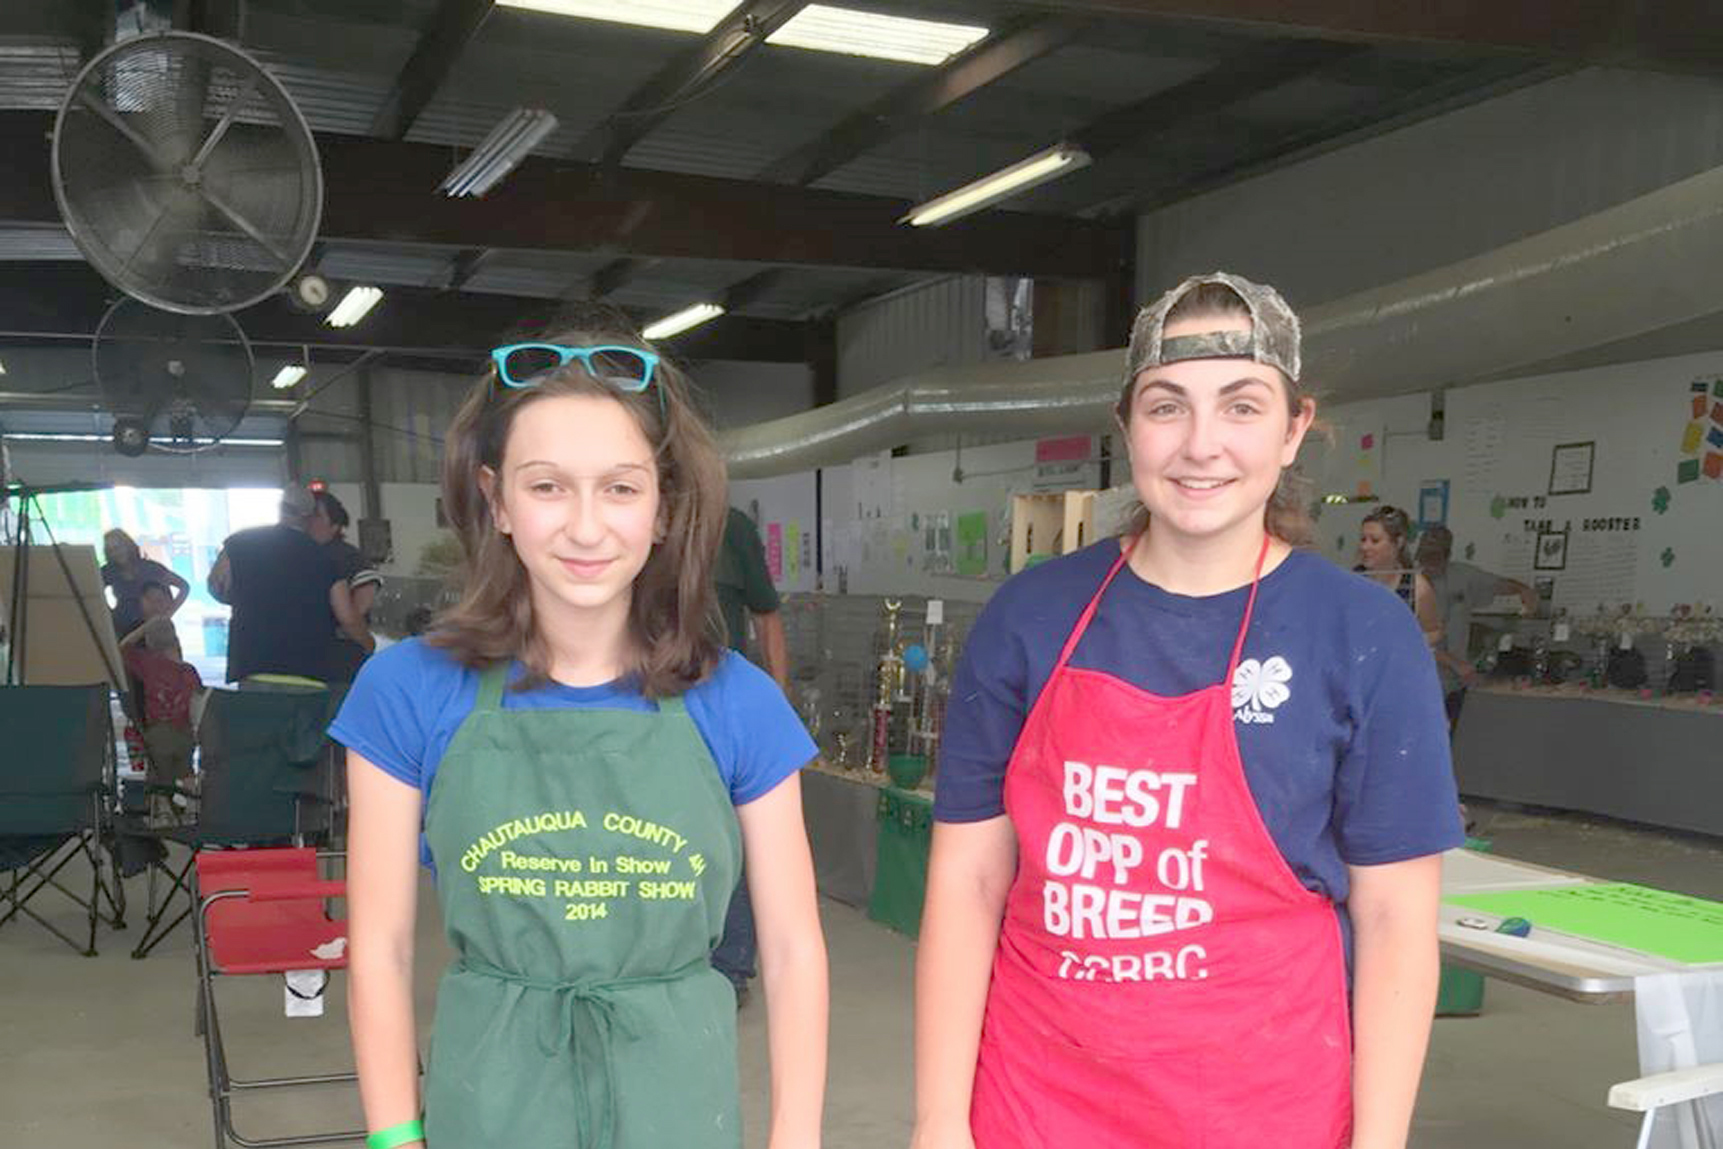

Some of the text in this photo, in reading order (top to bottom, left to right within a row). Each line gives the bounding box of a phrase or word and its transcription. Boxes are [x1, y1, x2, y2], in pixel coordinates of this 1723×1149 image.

[1582, 517, 1641, 531] ROOSTER
[1063, 761, 1197, 828] BEST
[461, 811, 587, 872] CHAUTAUQUA
[603, 813, 687, 853] COUNTY
[1046, 822, 1142, 884] OPP
[501, 851, 581, 872] Reserve
[616, 857, 671, 873] Show
[479, 876, 695, 898] SPRING RABBIT SHOW
[565, 903, 607, 920] 2014
[1043, 880, 1213, 939] BREED
